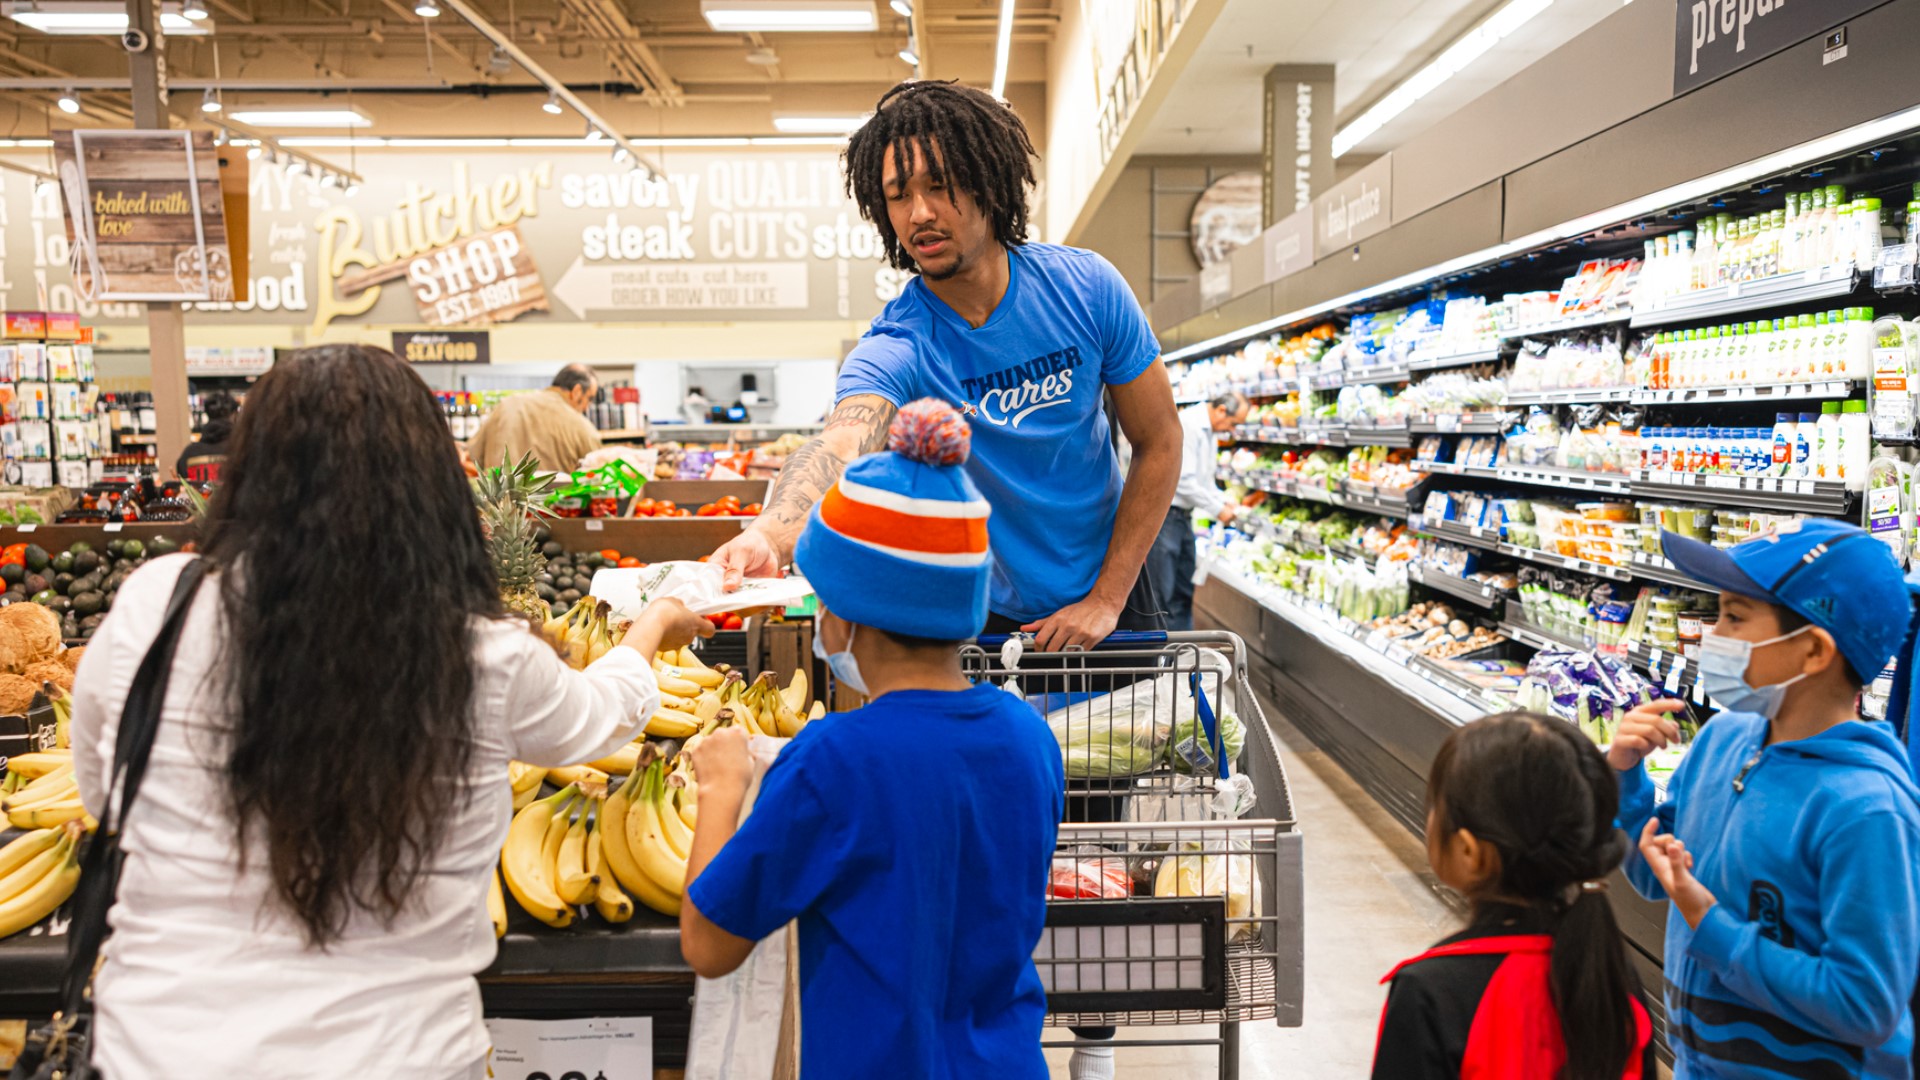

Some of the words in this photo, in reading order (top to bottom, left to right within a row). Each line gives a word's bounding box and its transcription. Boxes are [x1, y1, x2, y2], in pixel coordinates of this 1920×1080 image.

[1296, 82, 1312, 151] IMPORT
[95, 191, 147, 214] baked
[150, 191, 190, 214] with
[561, 172, 700, 222] savory
[707, 160, 850, 212] QUALIT
[98, 214, 135, 236] love
[313, 160, 553, 337] Butcher
[582, 210, 696, 261] steak
[709, 211, 809, 260] CUTS
[408, 230, 520, 303] SHOP
[611, 269, 650, 284] meat
[709, 287, 738, 305] YOU
[744, 286, 778, 305] LIKE
[405, 341, 478, 361] SEAFOOD
[960, 346, 1083, 400] THUNDER
[979, 368, 1073, 426] Cares
